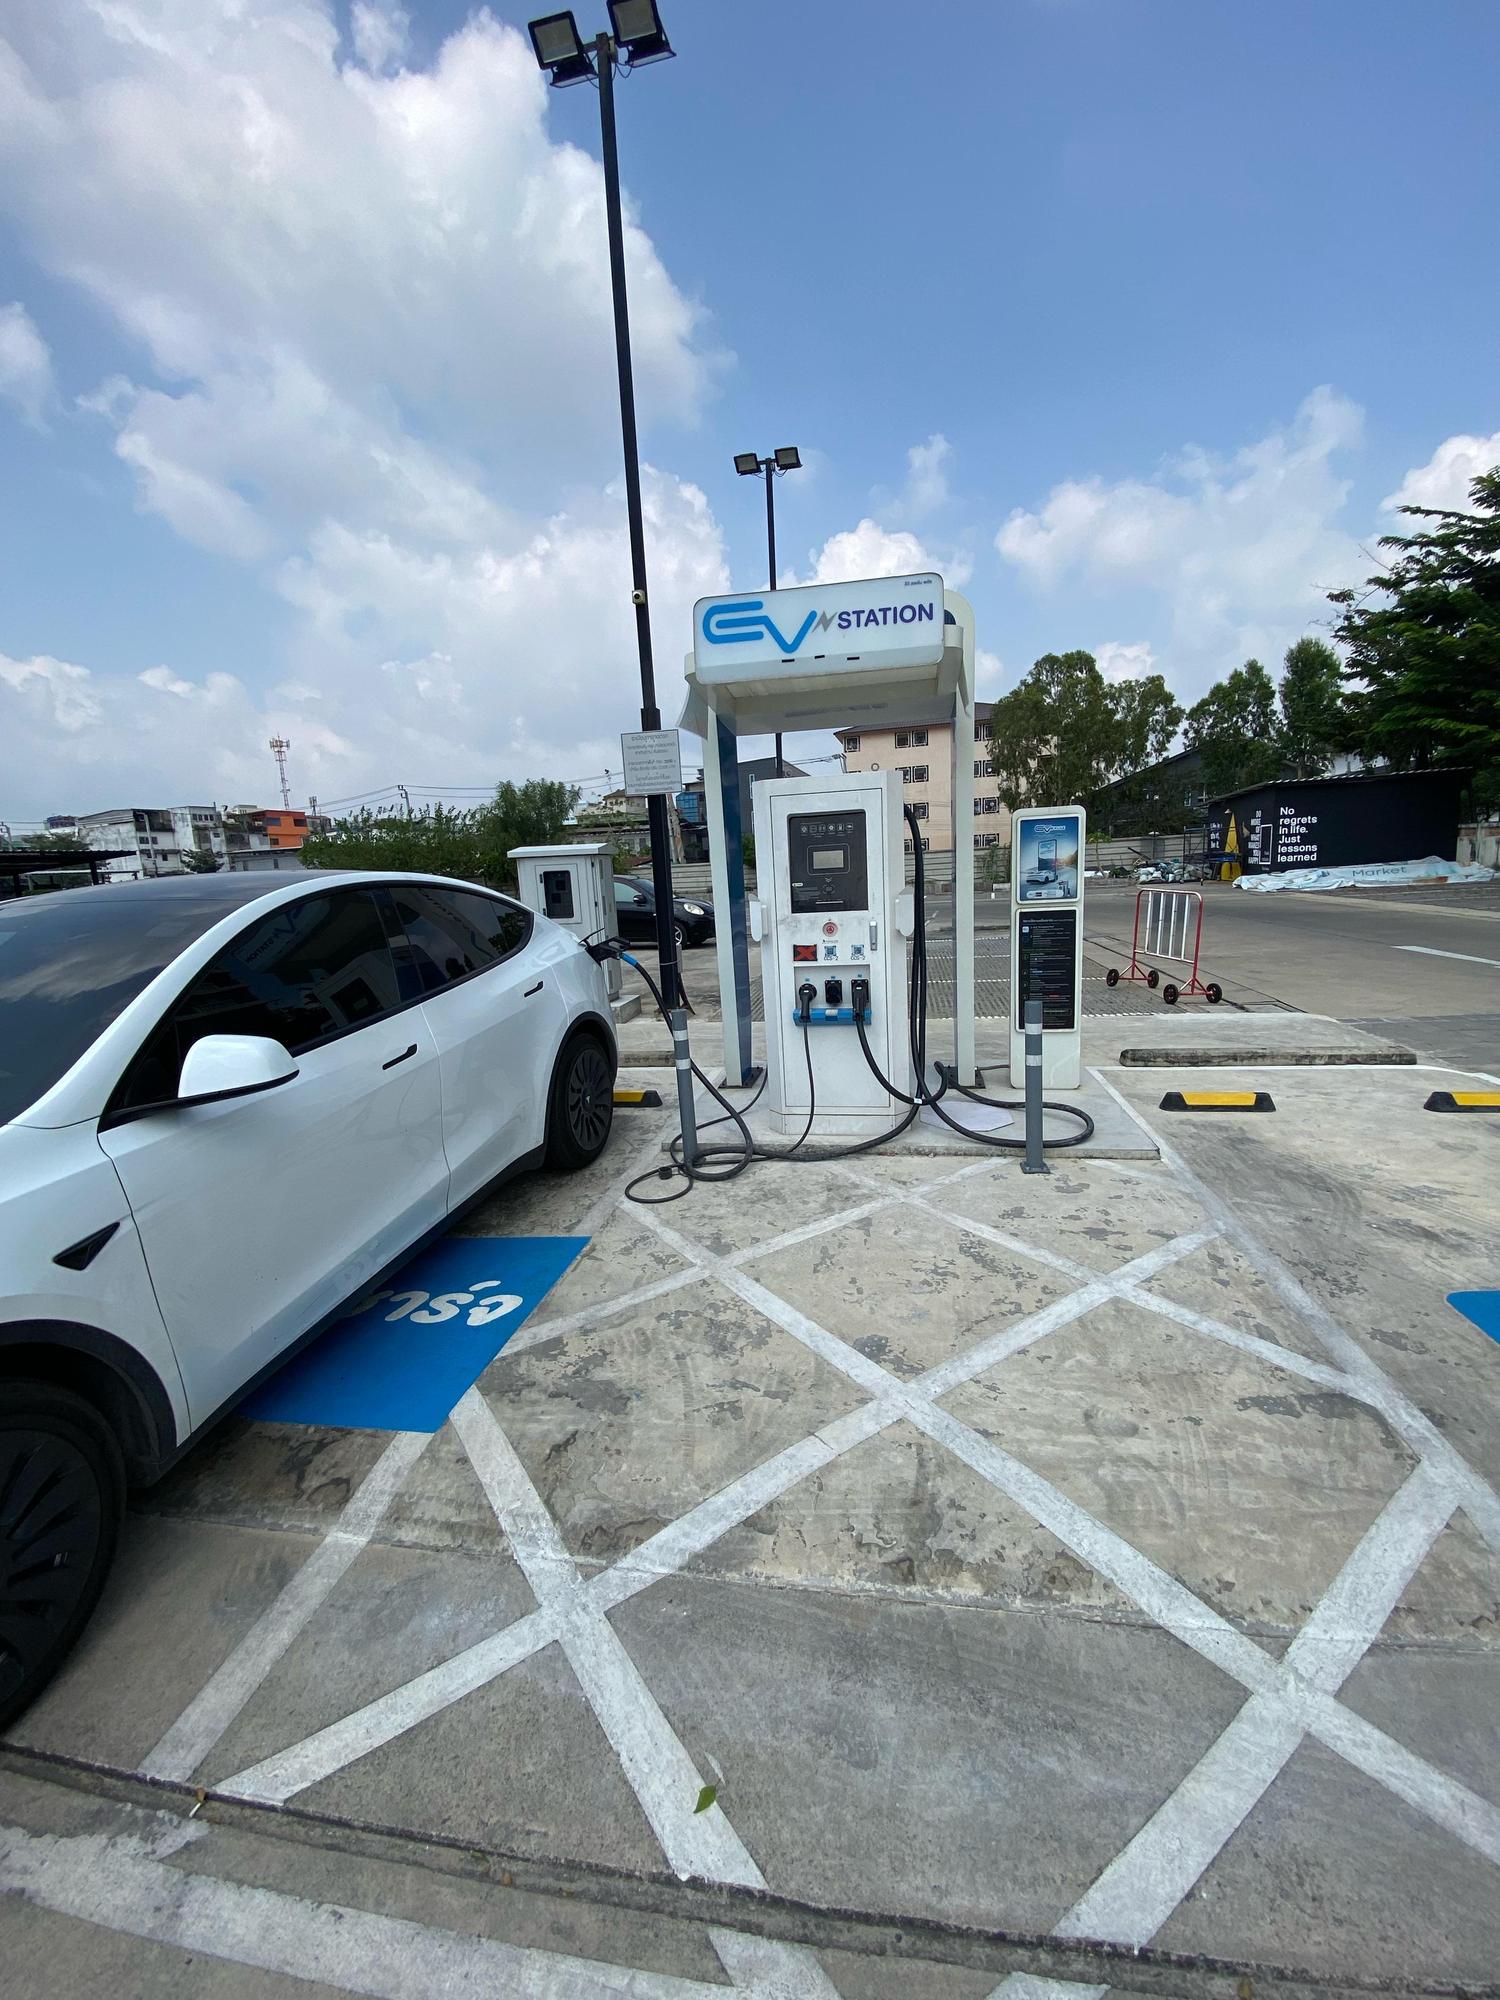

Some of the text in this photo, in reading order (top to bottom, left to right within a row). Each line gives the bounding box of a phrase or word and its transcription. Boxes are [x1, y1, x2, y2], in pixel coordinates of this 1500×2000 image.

[702, 600, 934, 654] EV STATION
[1280, 807, 1295, 816] No
[1279, 816, 1318, 826] regrets
[1279, 825, 1309, 834] in life.
[1279, 835, 1301, 844] Just
[1278, 844, 1318, 853] lessons
[1277, 853, 1317, 862] learned
[1352, 866, 1408, 877] Market
